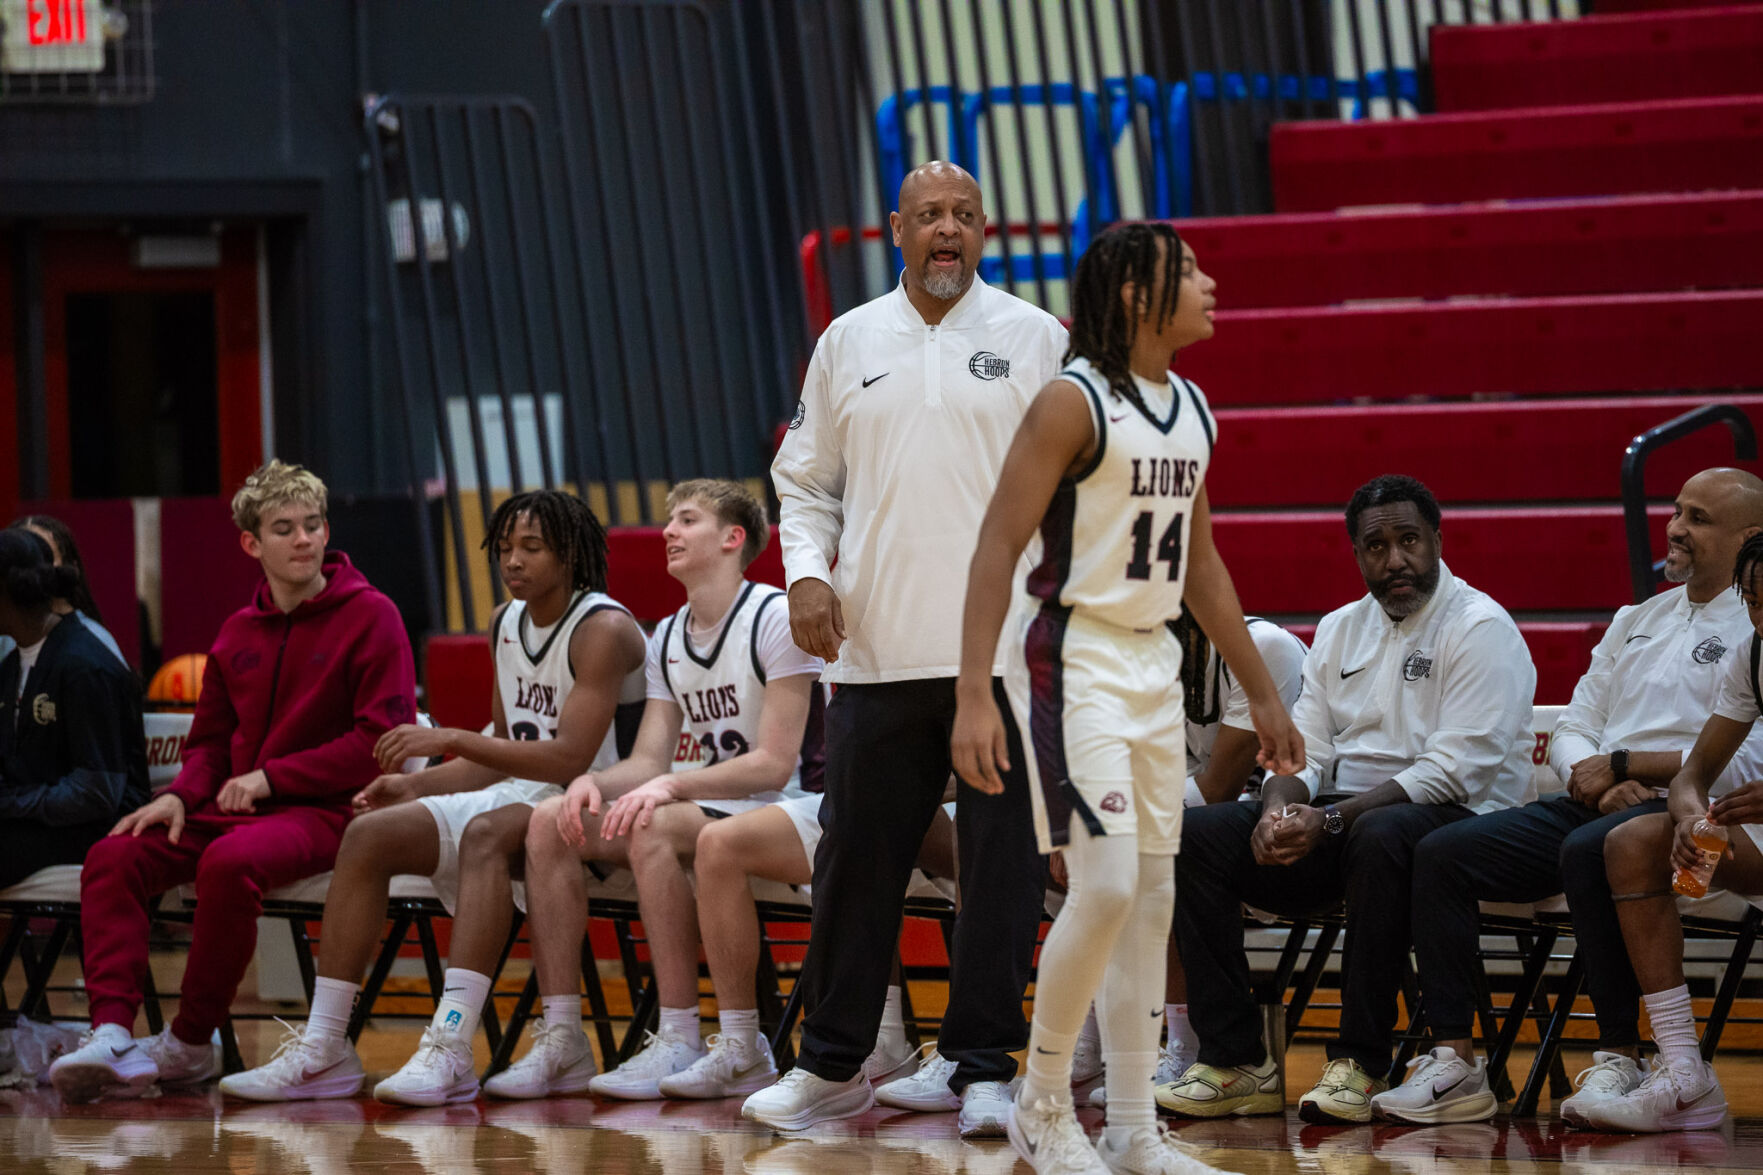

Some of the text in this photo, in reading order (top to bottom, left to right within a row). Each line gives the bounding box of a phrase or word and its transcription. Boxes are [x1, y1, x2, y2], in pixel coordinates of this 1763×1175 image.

[27, 0, 87, 45] EXIT
[984, 358, 1010, 368] HEBRON
[984, 366, 1010, 379] HOOPS
[1130, 458, 1198, 497] LIONS
[1126, 510, 1184, 582] 14
[682, 683, 740, 723] LIONS
